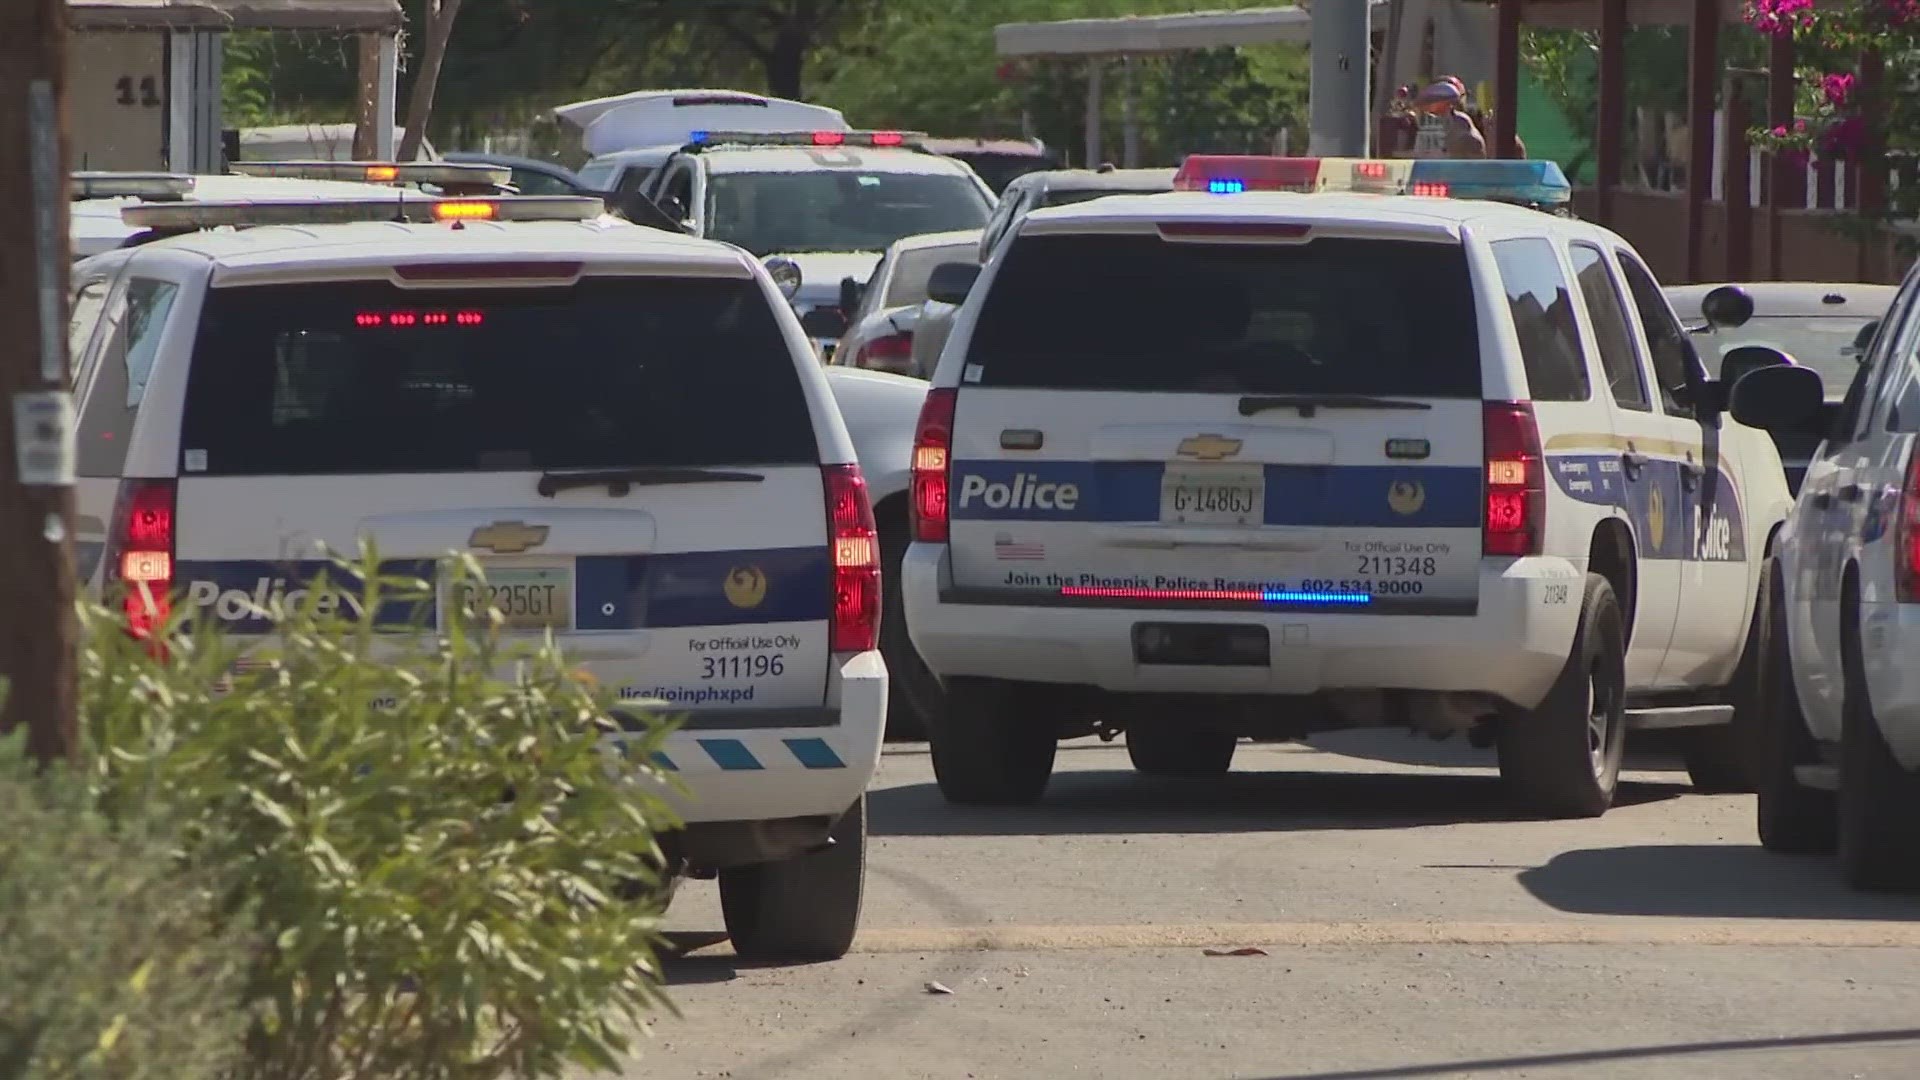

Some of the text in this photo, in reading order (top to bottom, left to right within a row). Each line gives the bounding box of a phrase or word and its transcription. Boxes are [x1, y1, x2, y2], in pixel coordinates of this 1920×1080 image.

[115, 76, 161, 109] 11
[959, 473, 1079, 510] Police
[1693, 503, 1731, 560] Police
[1358, 555, 1436, 576] 211348
[1004, 571, 1423, 594] Join the Phoenix Police Reserve 602.534.9000
[186, 577, 341, 621] Police
[689, 635, 800, 651] For Official Use Only
[701, 655, 784, 679] 311196
